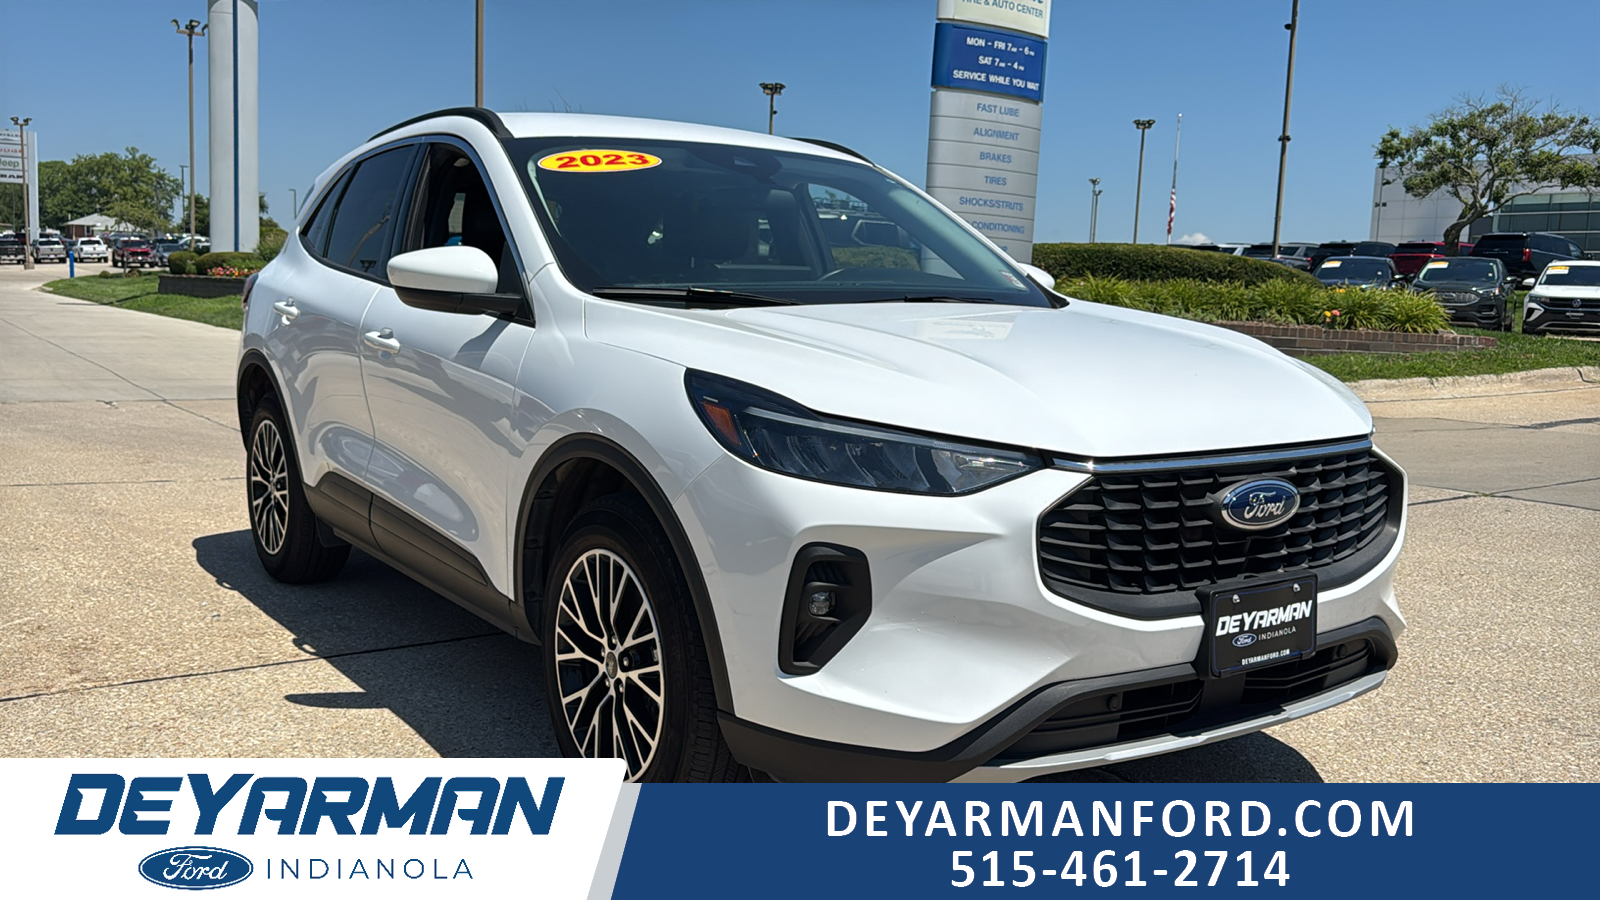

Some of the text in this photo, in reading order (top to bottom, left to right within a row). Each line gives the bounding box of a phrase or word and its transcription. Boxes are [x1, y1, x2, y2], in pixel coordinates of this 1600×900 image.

[992, 0, 1015, 11] AUTO
[1016, 3, 1044, 18] CENTER
[966, 36, 986, 47] MON
[993, 40, 1006, 51] FRI
[978, 55, 993, 66] SAT
[953, 69, 1040, 91] SERVICE WHILE YOU WAIT
[976, 103, 1020, 117] FAST LUBE
[973, 127, 1020, 141] ALIGNMENT
[555, 154, 650, 169] 2023
[979, 151, 1012, 164] BRAKES
[984, 175, 1007, 186] TIRES
[959, 196, 1024, 211] SHOCKS/STRUTS
[971, 220, 1025, 234] CONDITIONING
[1244, 491, 1286, 519] Ford
[1215, 600, 1312, 637] DEYARMAN
[1258, 626, 1297, 641] INDIANOLA
[1241, 648, 1290, 665] DEYARMANFORD.COM
